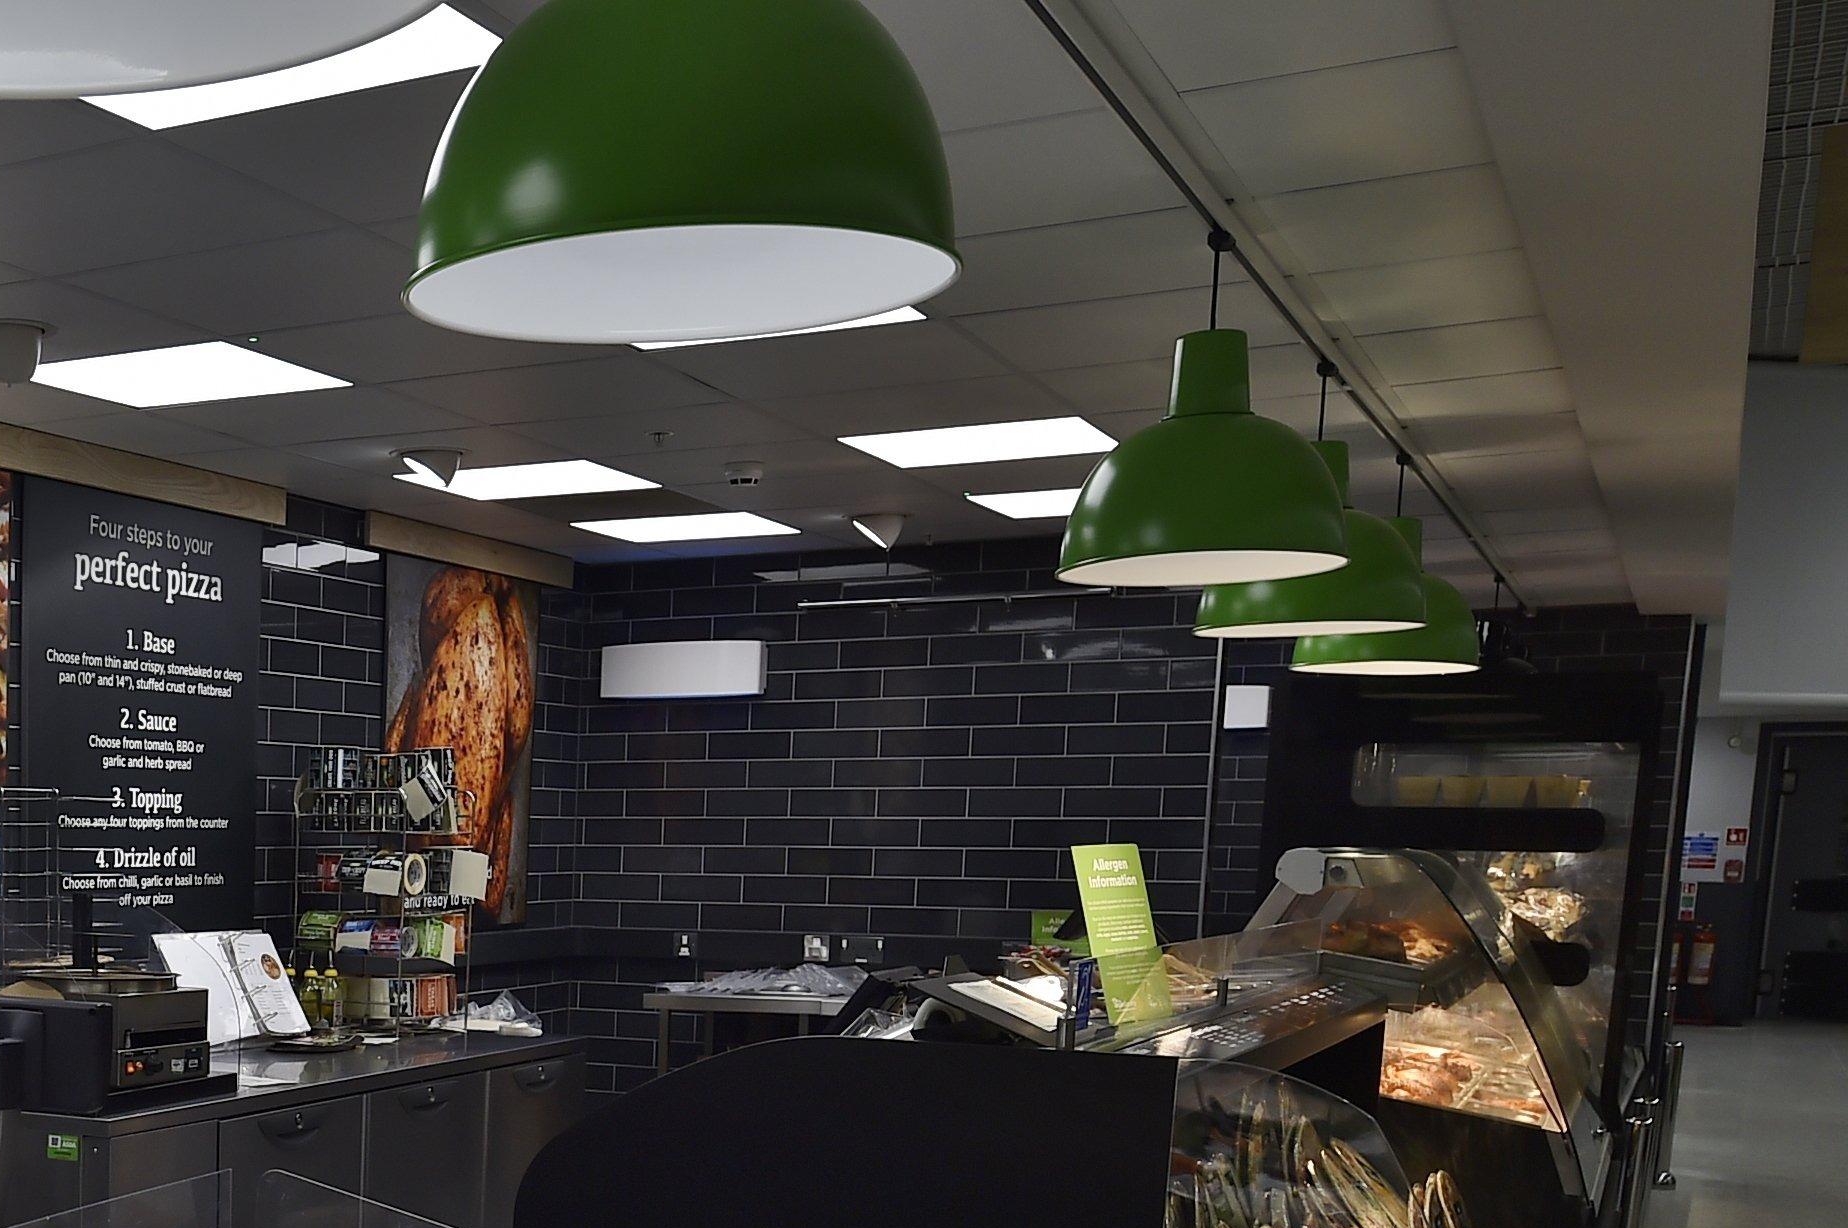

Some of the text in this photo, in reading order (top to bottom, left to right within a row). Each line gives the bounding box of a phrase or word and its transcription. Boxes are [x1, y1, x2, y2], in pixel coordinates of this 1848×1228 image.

[90, 514, 214, 556] Four steps to your
[74, 551, 222, 604] perfect pizza
[126, 629, 175, 654] 1. Base
[46, 649, 243, 682] Choose from thin and crispy, stonebaked or deep
[58, 672, 75, 685] pan
[97, 675, 114, 687] and
[136, 678, 164, 691] stuffed
[166, 681, 186, 693] crust
[187, 684, 196, 694] or
[197, 683, 232, 698] flatbread
[120, 708, 177, 731] 2. Sauce
[88, 735, 204, 753] Choose from tomato, BBQ or
[102, 755, 192, 771] garlic and herb spread
[112, 787, 183, 814] 3. Topping
[58, 815, 229, 830] Choose any four toppings from the counter
[95, 846, 196, 868] 4. Drizzle of oil
[1092, 858, 1129, 872] Allergen
[62, 876, 95, 889] Choose
[96, 875, 116, 888] from
[141, 874, 163, 889] garlic
[164, 877, 173, 886] or
[175, 874, 193, 886] basil
[194, 875, 202, 885] to
[204, 873, 224, 885] finish
[1088, 874, 1138, 888] Information
[119, 893, 174, 908] off your pizza
